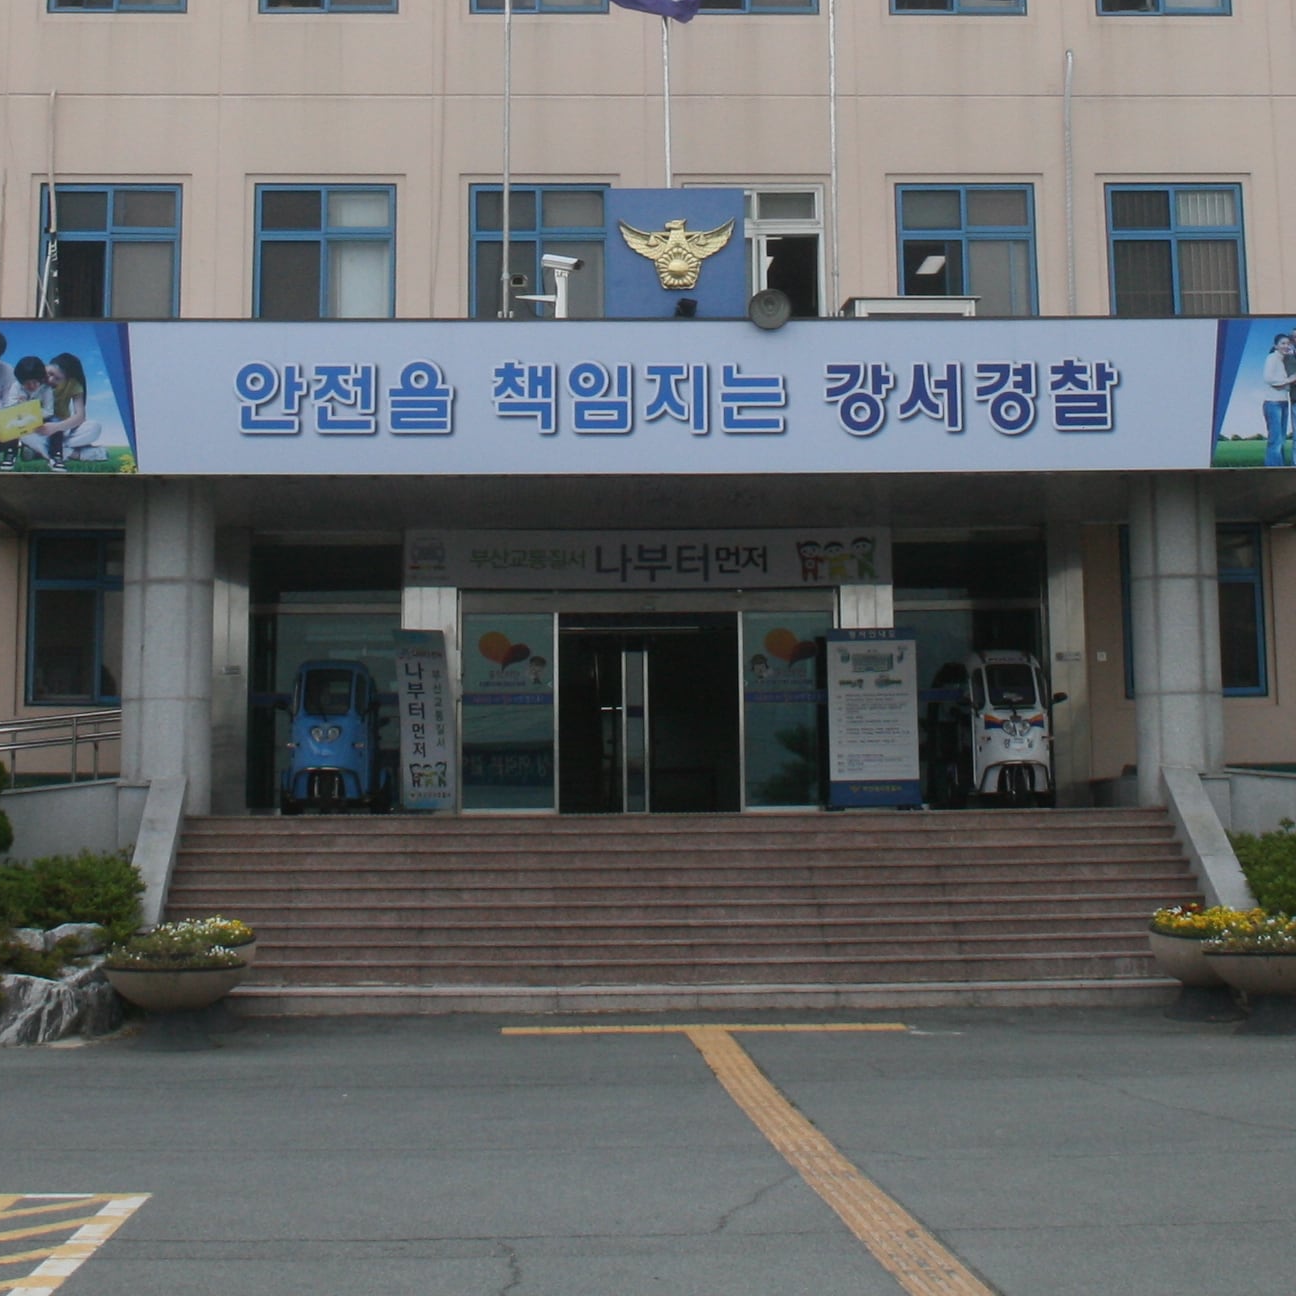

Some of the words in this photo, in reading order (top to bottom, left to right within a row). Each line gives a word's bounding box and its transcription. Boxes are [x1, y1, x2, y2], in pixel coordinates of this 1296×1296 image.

[234, 359, 457, 436] 안전을
[492, 358, 788, 436] 책임지는
[822, 356, 1121, 437] 강서경찰
